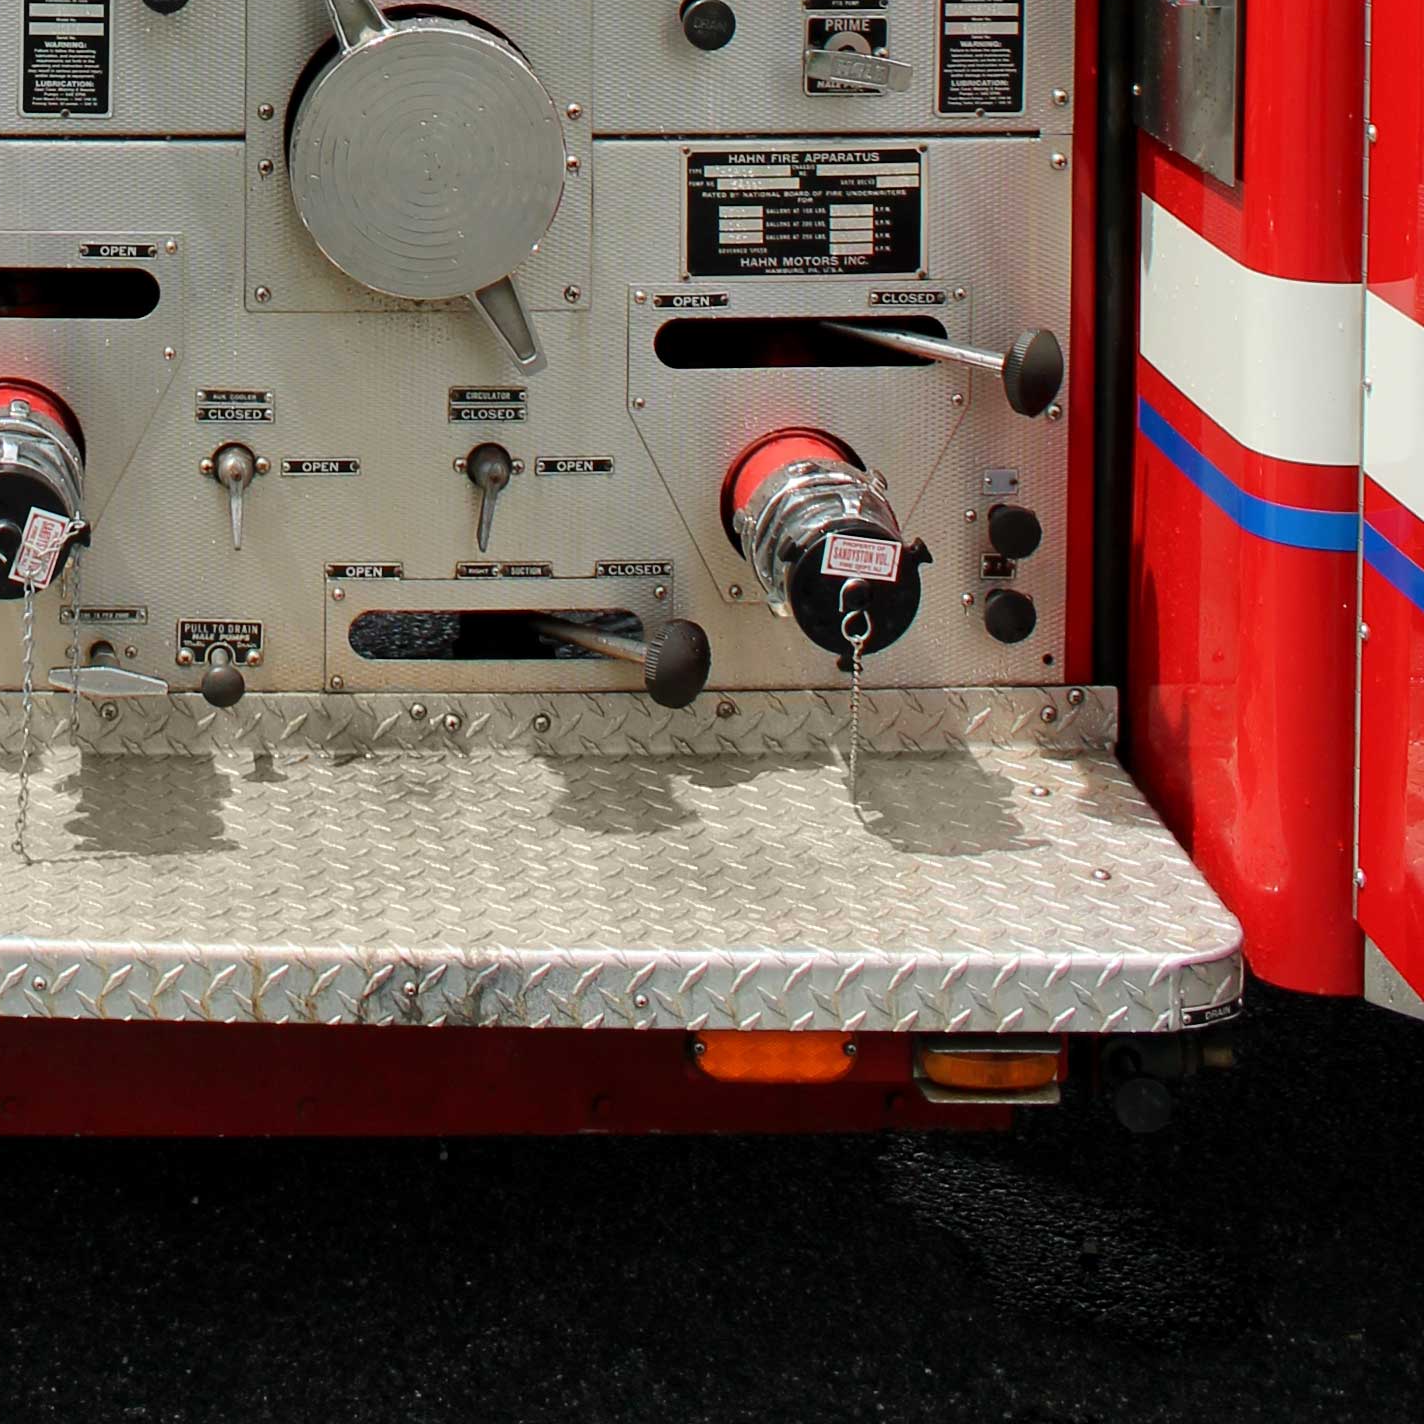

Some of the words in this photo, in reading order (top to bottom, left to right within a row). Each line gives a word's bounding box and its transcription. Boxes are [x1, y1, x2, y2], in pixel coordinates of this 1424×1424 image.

[825, 19, 870, 32] PRIME
[44, 41, 87, 49] WARNING:
[35, 80, 95, 88] LUBRICATION:
[950, 79, 1009, 87] LUBRICATION:
[728, 154, 766, 164] HAHN
[770, 153, 800, 164] FIRE
[804, 152, 880, 163] APPARATUS
[100, 245, 137, 257] OPEN
[740, 257, 778, 268] HAHN
[782, 256, 840, 267] MOTORS
[844, 256, 869, 266] INC.
[672, 296, 710, 307] OPEN
[881, 293, 935, 304] CLOSED
[465, 391, 511, 400] CIRCULATOR
[208, 409, 262, 420] CLOSED
[461, 409, 516, 420] CLOSED
[301, 462, 340, 473] OPEN
[556, 461, 594, 472] OPEN
[345, 567, 383, 577] OPEN
[510, 567, 542, 576] SUCTION
[608, 564, 662, 575] CLOSED
[184, 624, 207, 634] PULL
[208, 624, 224, 634] TO
[227, 624, 258, 634] DRAIN
[1204, 1005, 1232, 1020] DRAIN
